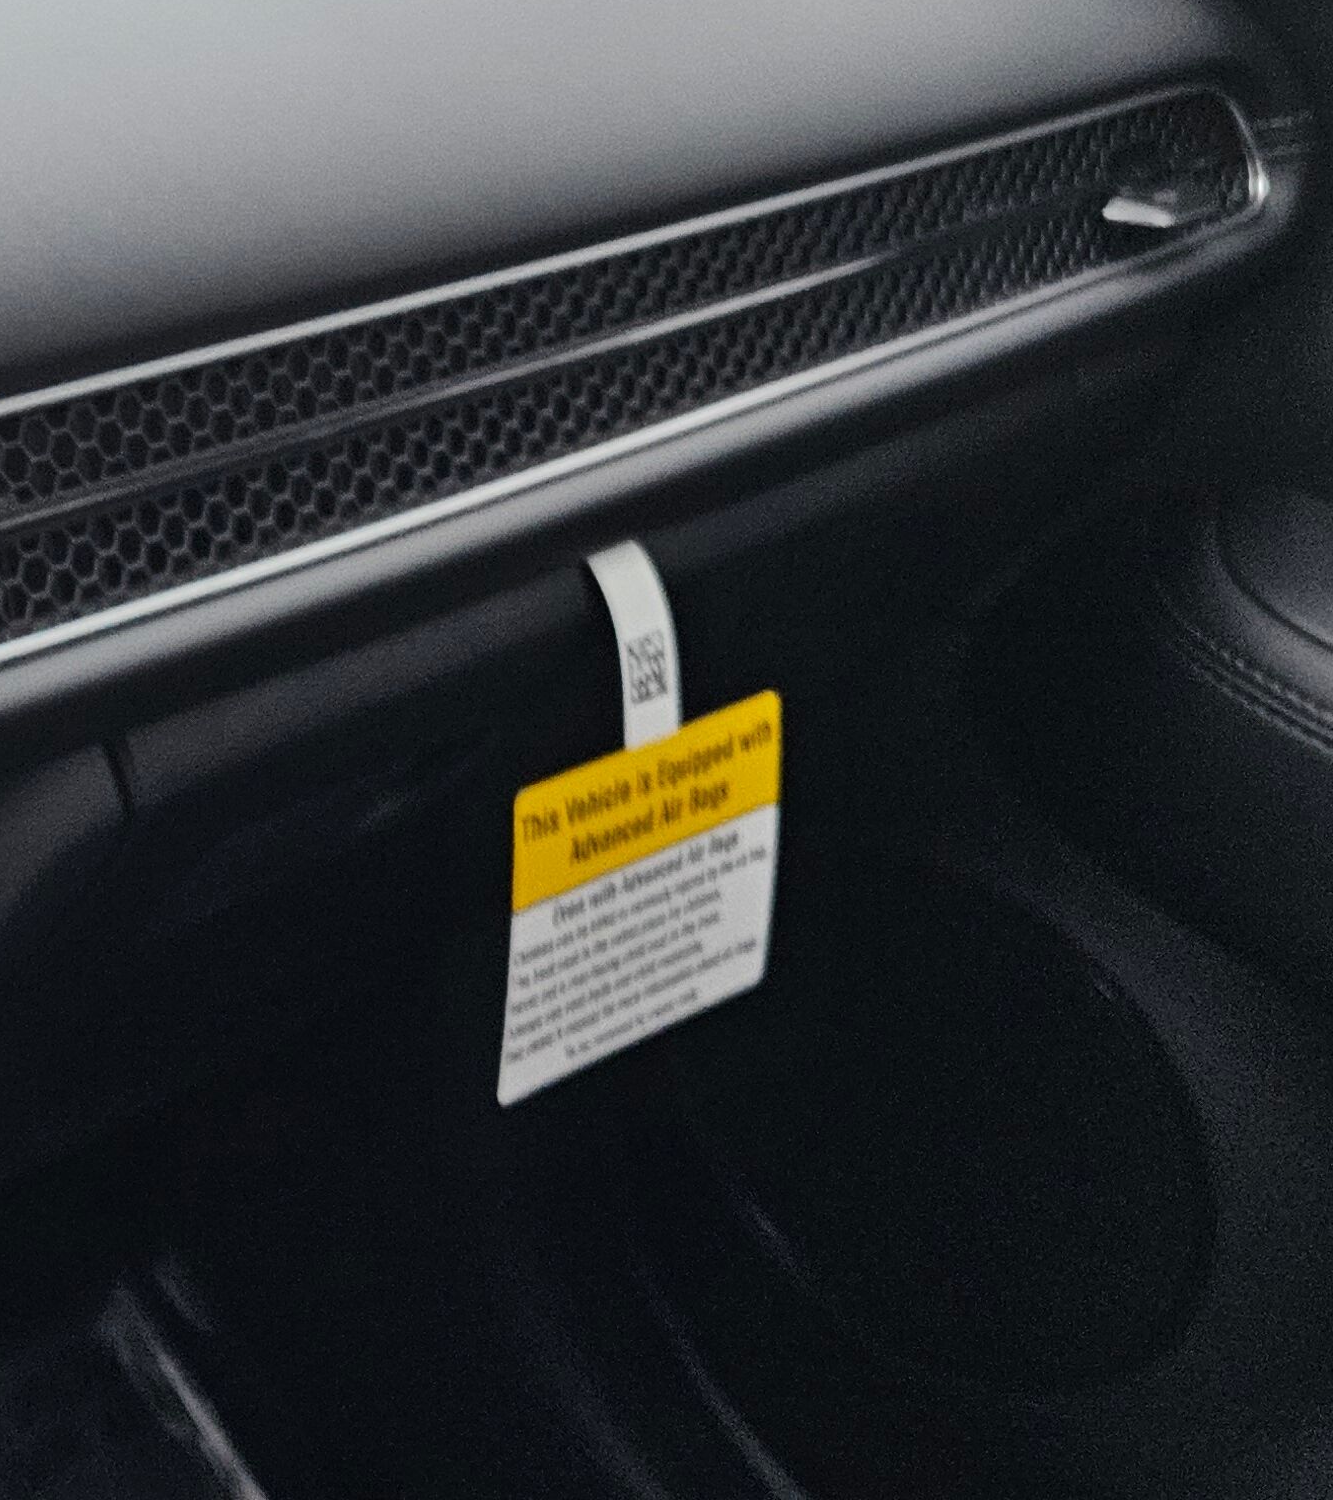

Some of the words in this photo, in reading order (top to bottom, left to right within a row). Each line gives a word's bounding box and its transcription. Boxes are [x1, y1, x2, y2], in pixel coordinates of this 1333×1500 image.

[522, 808, 560, 843] This
[566, 780, 630, 825] Vehicle
[657, 734, 733, 788] Equipped
[739, 722, 771, 752] with
[571, 808, 654, 865] Advanced
[660, 800, 681, 827] Air
[689, 781, 729, 816] Bags
